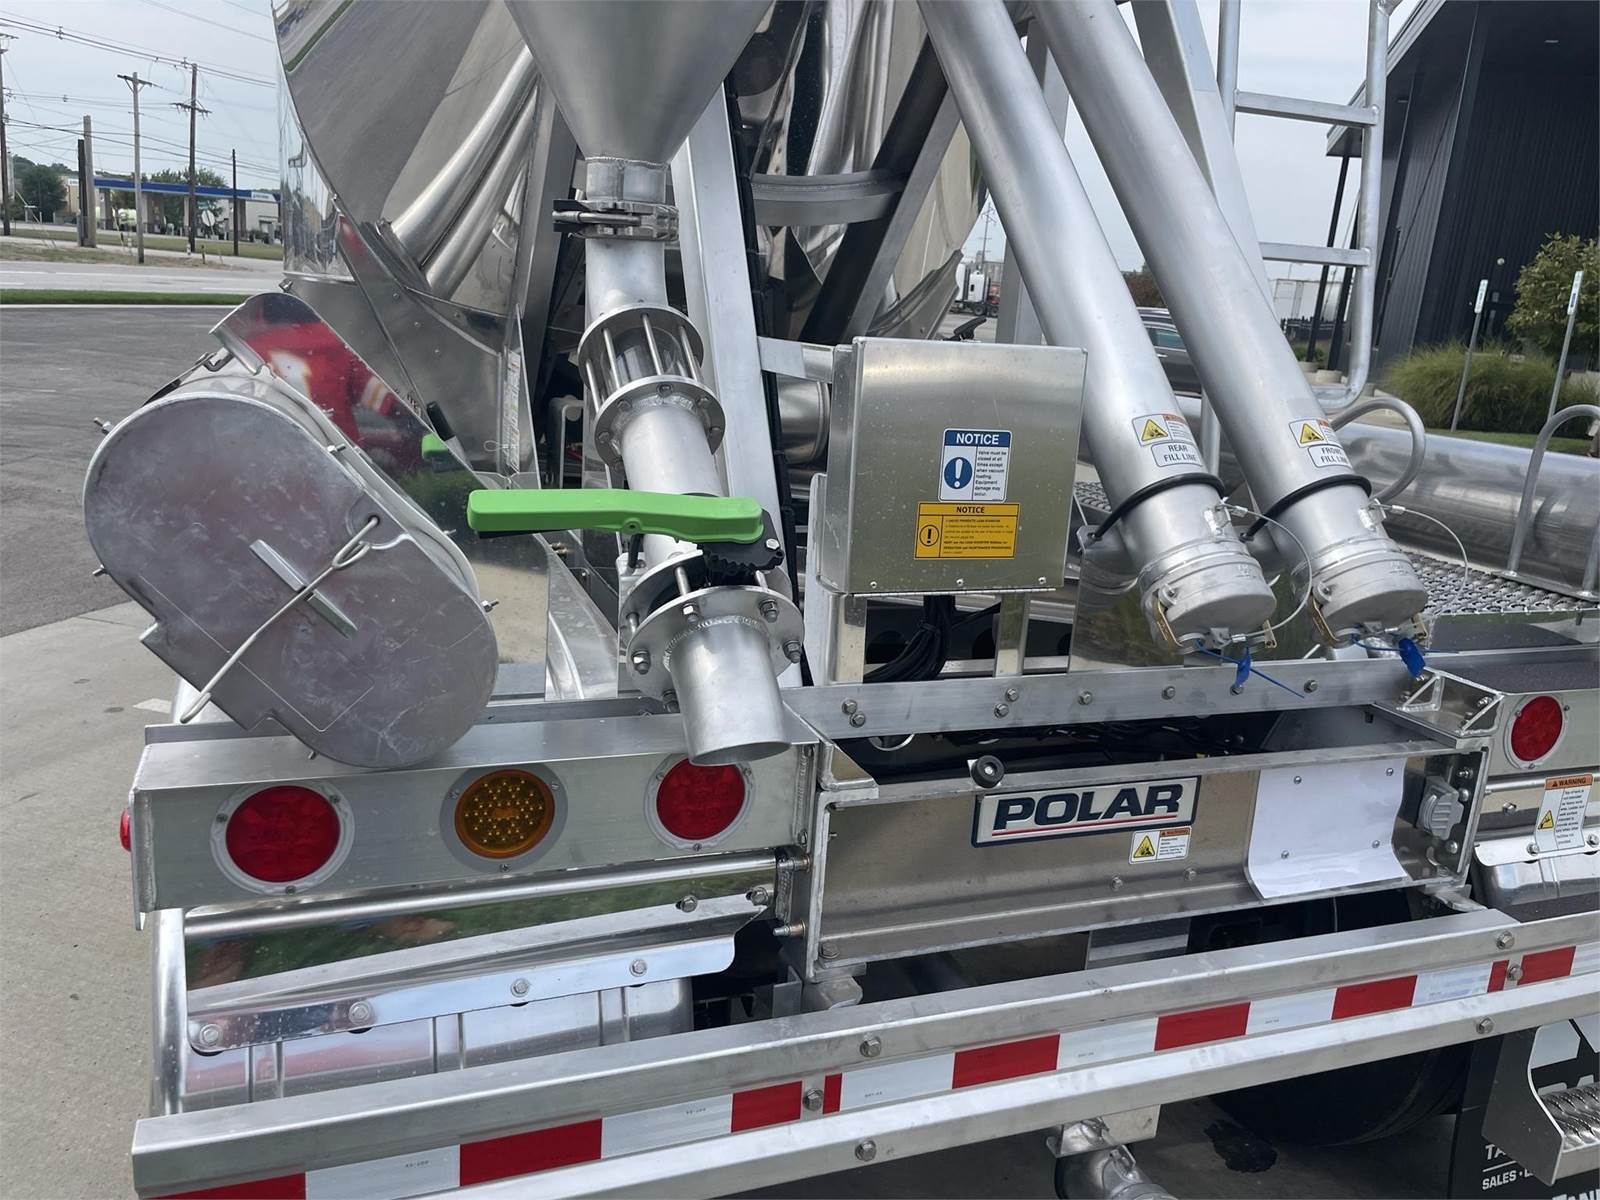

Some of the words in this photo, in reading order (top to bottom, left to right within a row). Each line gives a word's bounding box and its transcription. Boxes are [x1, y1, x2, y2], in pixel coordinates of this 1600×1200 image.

[956, 433, 999, 445] NOTICE
[1163, 454, 1182, 462] FILL
[1320, 455, 1336, 463] FILL
[956, 506, 985, 514] NOTICE
[1559, 777, 1587, 786] WARNING
[993, 783, 1184, 831] POLAR
[1482, 1169, 1517, 1190] SALES
